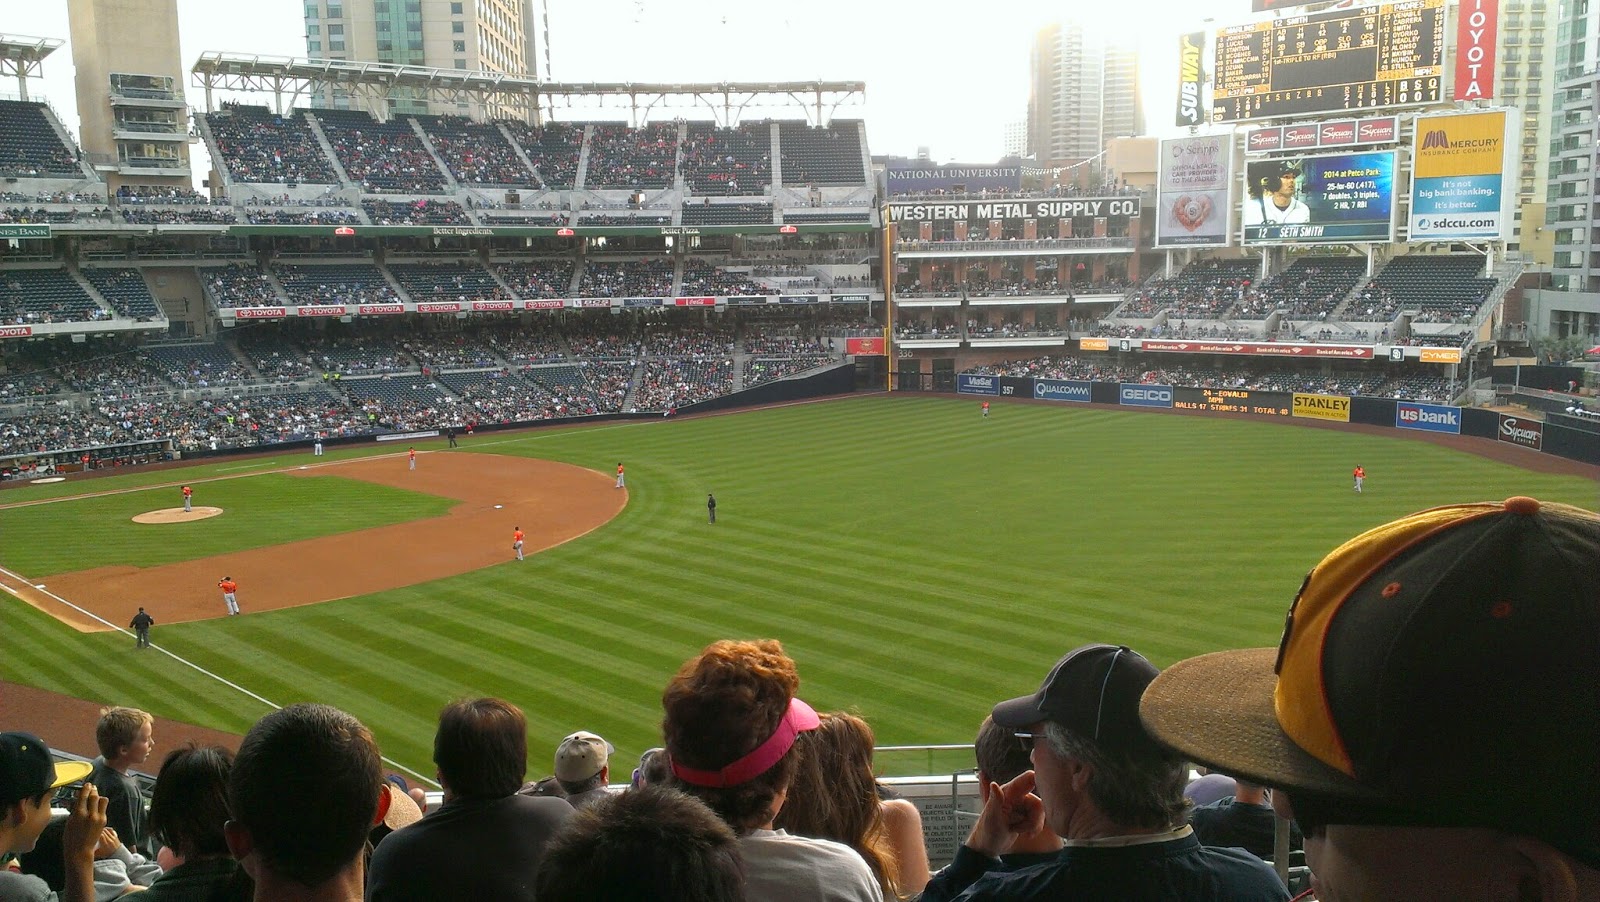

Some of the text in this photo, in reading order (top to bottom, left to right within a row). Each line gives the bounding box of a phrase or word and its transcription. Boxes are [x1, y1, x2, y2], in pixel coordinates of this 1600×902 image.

[1393, 1, 1425, 11] PADRES
[1286, 16, 1308, 26] SMITH
[1180, 34, 1200, 123] SUBWAY
[1322, 127, 1354, 140] Sycuan
[1360, 124, 1392, 137] Sycuan
[1250, 133, 1279, 145] Sycuan
[1285, 130, 1316, 143] Sycuan
[1450, 138, 1499, 149] MERCURY
[1186, 145, 1219, 156] Scripps
[889, 167, 1017, 180] NATIONAL UNIVERSITY
[1188, 169, 1217, 177] PROVIDER
[1323, 171, 1339, 179] 2014
[1347, 169, 1364, 178] Petco
[1419, 187, 1495, 199] big bank banking.
[889, 200, 1139, 221] WESTERN METAL SUPPLY CO.
[1433, 218, 1495, 229] sdccu.com
[19, 227, 47, 236] BANK
[433, 227, 454, 235] Better
[1258, 225, 1325, 238] 12 SETH SMITH
[252, 309, 282, 317] TOYOTA
[898, 350, 914, 358] 336
[1421, 351, 1459, 359] CYMER
[968, 376, 993, 386] ViaSat
[1002, 385, 1014, 395] 357
[1036, 382, 1090, 397] QUALCOMM
[1122, 388, 1171, 401] GEICO
[1294, 396, 1348, 411] STANLEY
[1240, 405, 1248, 413] 31
[1253, 406, 1277, 415] TOTAL
[1293, 408, 1324, 417] PERFORMANCE
[1503, 418, 1542, 441] Sycuan
